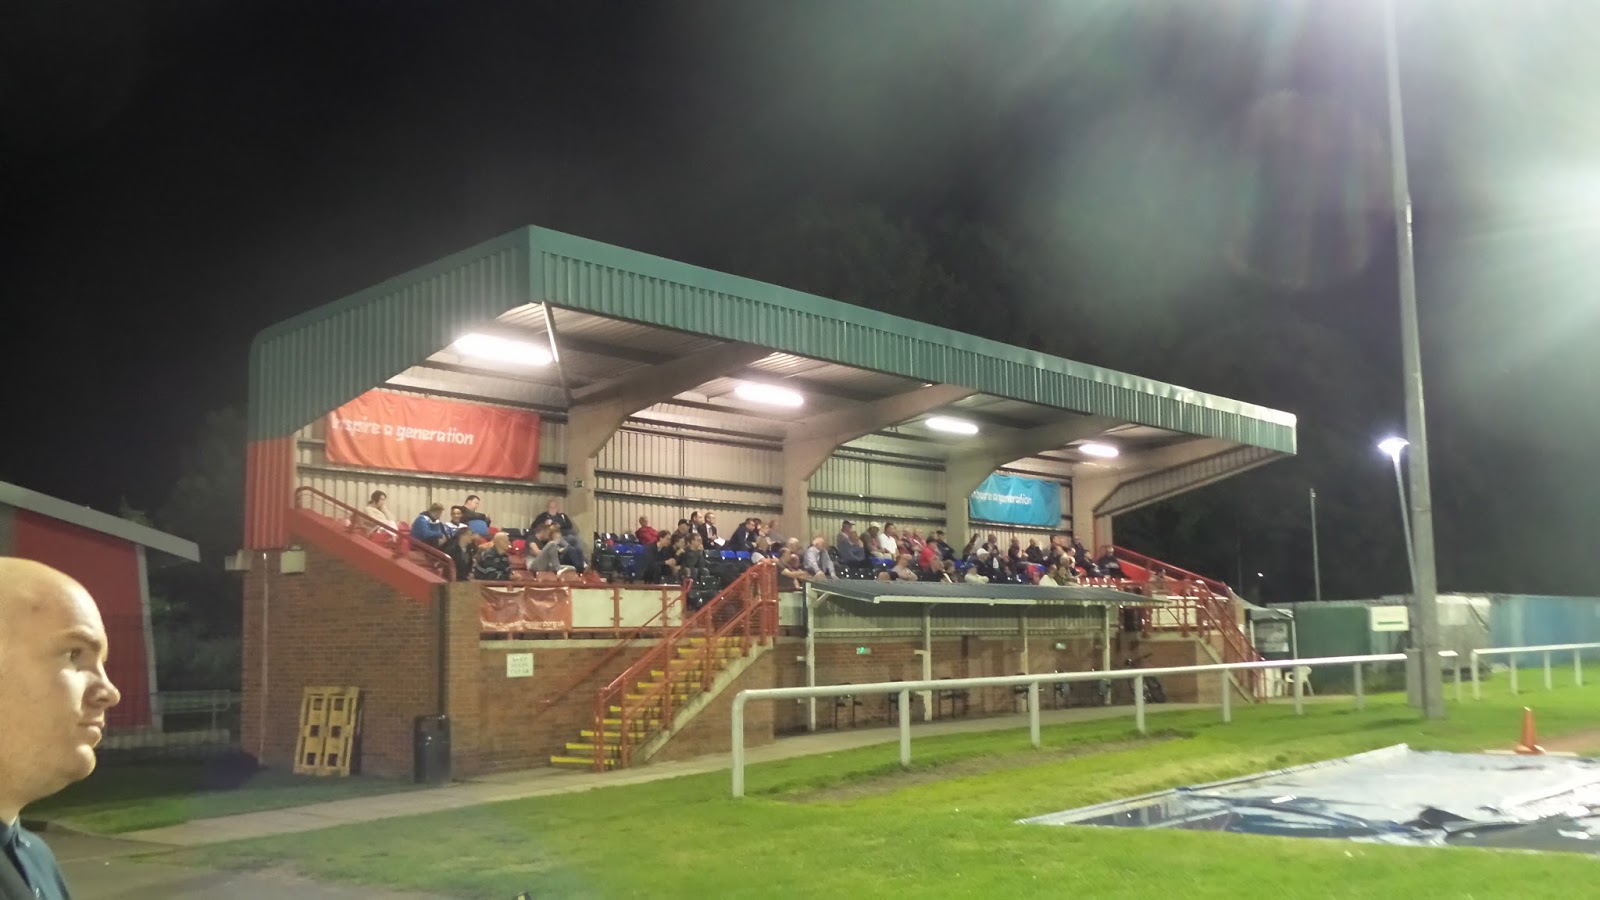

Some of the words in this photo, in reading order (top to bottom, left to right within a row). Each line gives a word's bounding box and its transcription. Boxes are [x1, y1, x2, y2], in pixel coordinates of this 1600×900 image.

[330, 411, 381, 437] Ispire
[383, 423, 393, 437] a
[395, 425, 474, 445] generation
